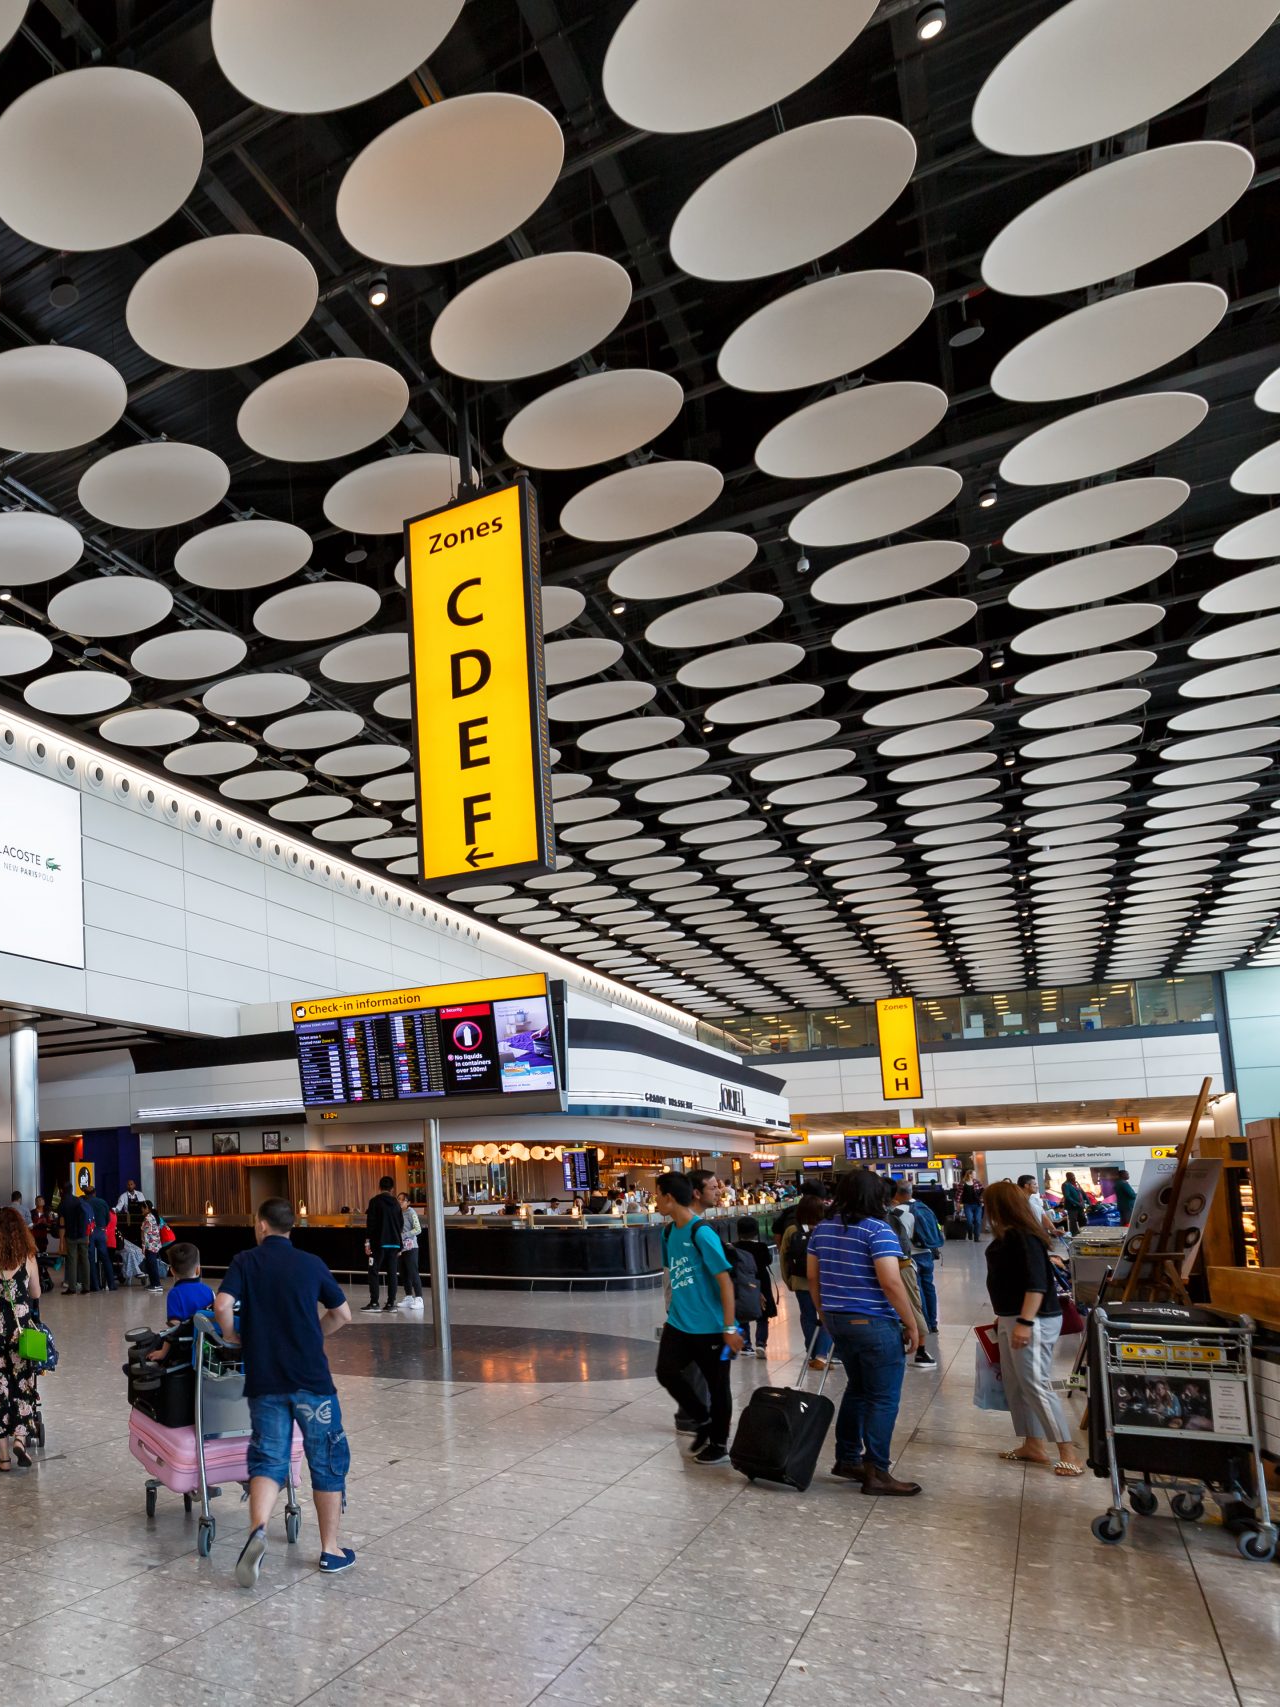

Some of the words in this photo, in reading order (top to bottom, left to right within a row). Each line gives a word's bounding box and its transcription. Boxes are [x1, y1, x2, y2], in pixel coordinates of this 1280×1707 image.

[429, 516, 504, 555] Zones
[446, 576, 484, 627] C
[450, 648, 492, 700] D
[458, 715, 491, 771] E
[462, 792, 492, 846] F
[3, 861, 19, 873] NEW
[308, 1002, 353, 1015] Check-in
[356, 994, 421, 1010] information
[893, 1057, 908, 1071] G
[895, 1077, 909, 1091] H
[1123, 1122, 1135, 1132] H
